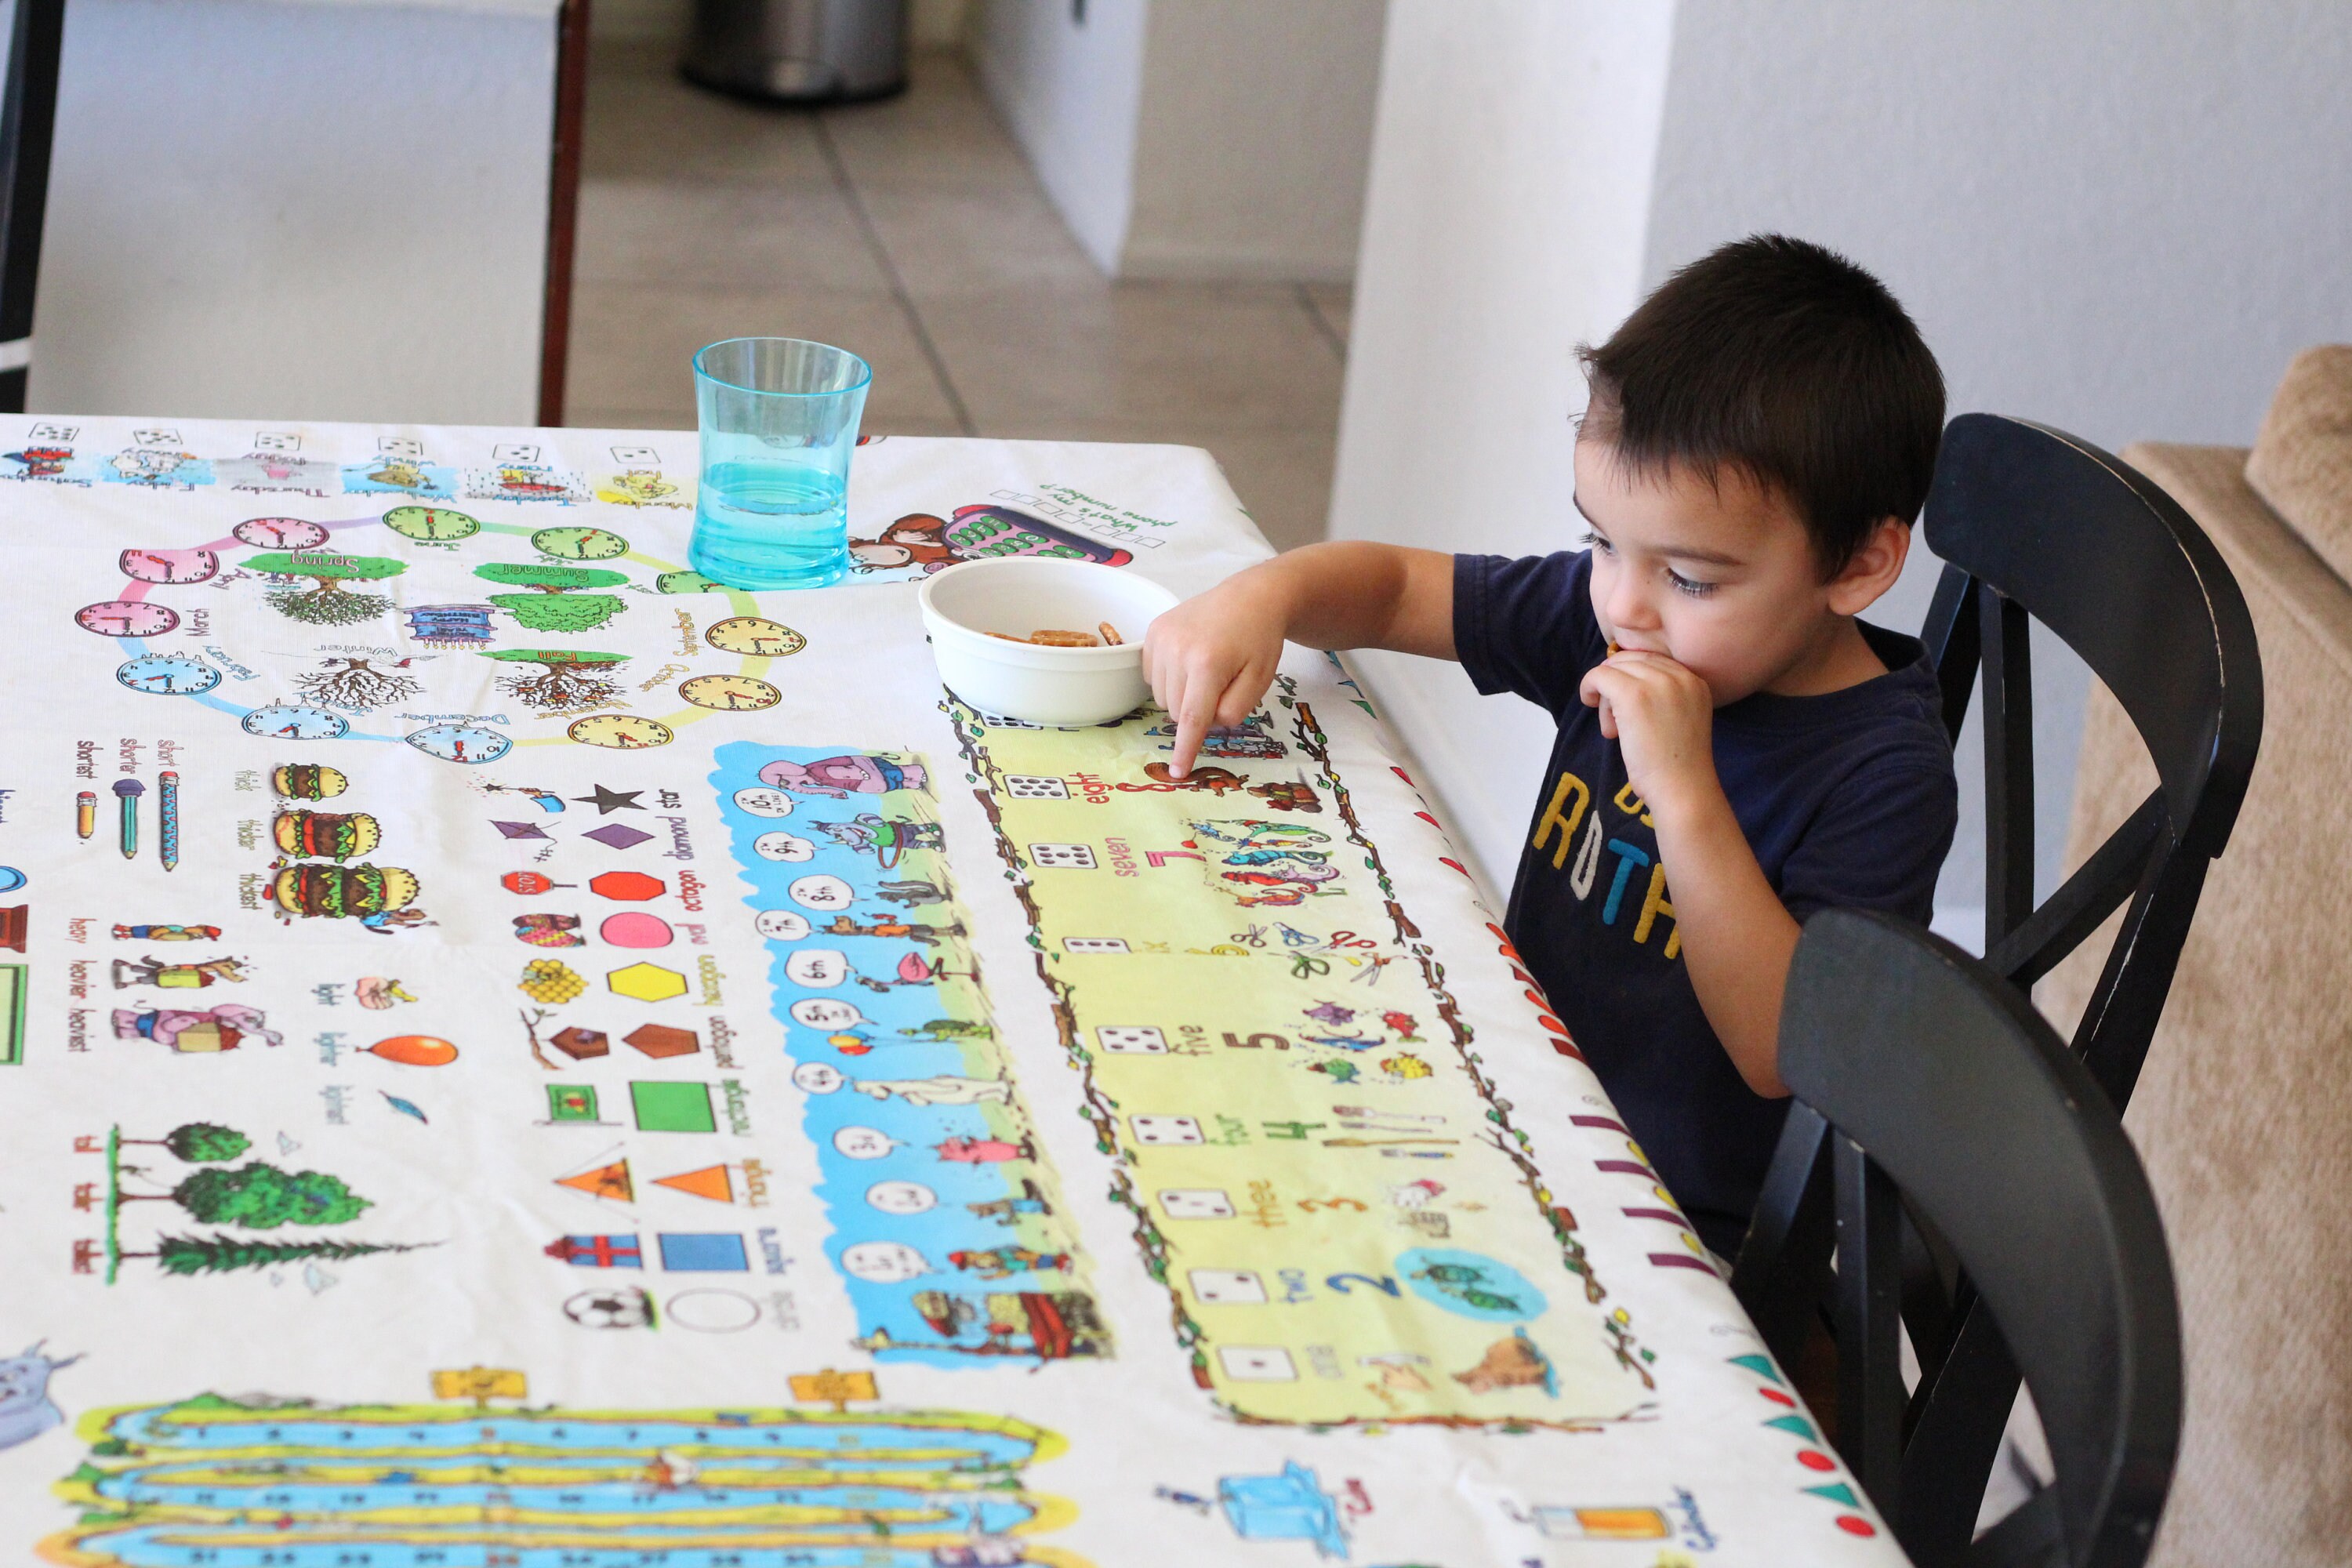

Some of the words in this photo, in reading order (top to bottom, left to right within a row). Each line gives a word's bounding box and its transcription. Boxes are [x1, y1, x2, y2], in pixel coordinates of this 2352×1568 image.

[372, 454, 437, 467] windy
[495, 463, 553, 472] rainy
[0, 473, 93, 488] Saturda
[627, 469, 662, 479] hot
[230, 484, 331, 498] Thursday
[492, 494, 577, 506] Tuesday
[1047, 492, 1075, 506] my
[612, 499, 693, 511] Monday
[1079, 507, 1138, 532] What's
[1122, 510, 1177, 528] phone
[291, 550, 360, 573] Spring
[497, 564, 589, 583] Summer
[183, 608, 212, 637] March
[671, 608, 705, 657] September
[313, 644, 398, 657] Winter
[537, 651, 578, 661] Fall
[394, 712, 510, 725] December
[76, 740, 104, 779] shortest
[119, 738, 147, 775] shorter
[158, 739, 184, 767] short
[235, 770, 262, 792] thick
[1064, 771, 1115, 804] eight
[1116, 782, 1177, 793] 8
[655, 788, 683, 809] star
[750, 793, 772, 810] 10th
[655, 815, 695, 861] diamond
[774, 840, 799, 855] 9th
[1104, 837, 1140, 877] seven
[1145, 850, 1207, 868] 7
[239, 873, 266, 909] thickest
[517, 871, 537, 894] STOP
[674, 869, 707, 912] octagon
[810, 885, 837, 902] 8th
[64, 918, 97, 944] heavy
[673, 923, 710, 946] oval
[68, 960, 98, 1000] heavier
[801, 960, 828, 978] 6th
[691, 954, 727, 1007] hexagon
[703, 1015, 746, 1069] pentagon
[1170, 1025, 1213, 1057] five
[1221, 1031, 1290, 1051] 5
[1261, 1120, 1327, 1140] 4
[1297, 1196, 1369, 1213] 3
[1325, 1272, 1403, 1299] 2
